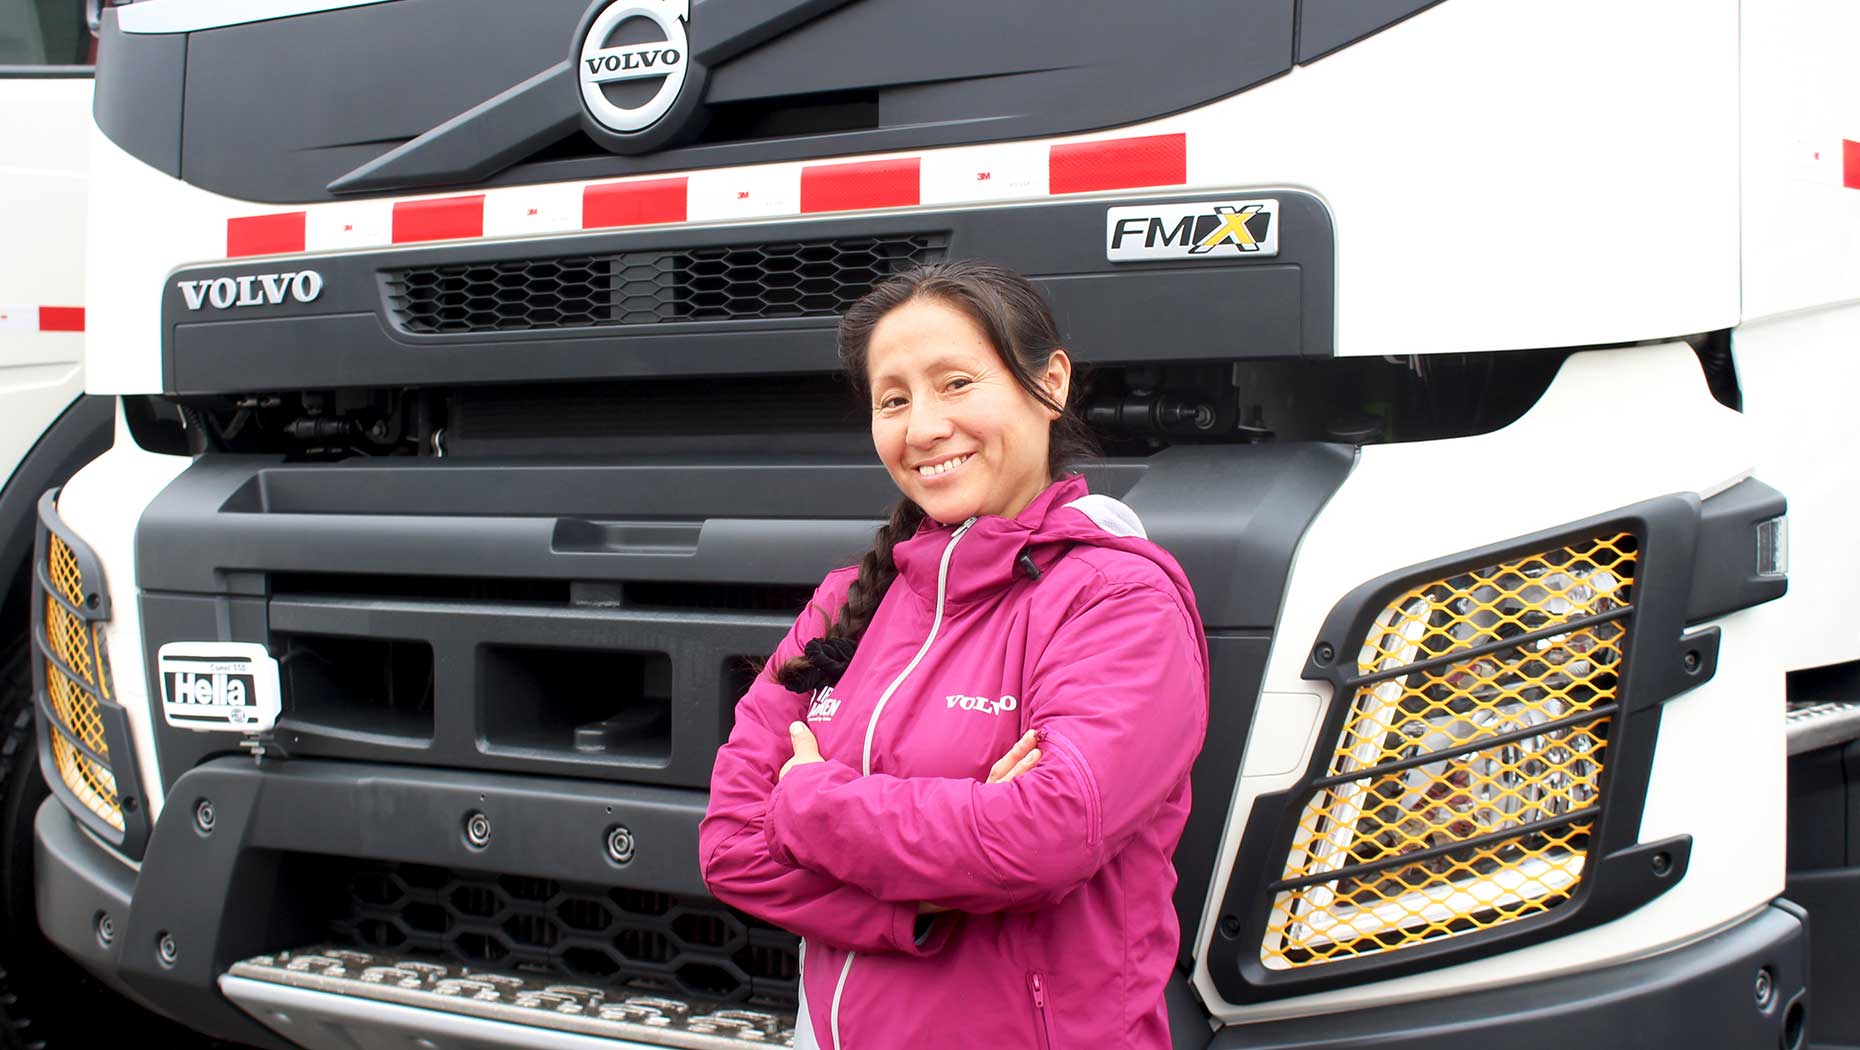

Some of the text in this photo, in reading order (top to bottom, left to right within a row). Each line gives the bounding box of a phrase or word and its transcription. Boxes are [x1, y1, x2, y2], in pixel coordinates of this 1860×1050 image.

[585, 49, 681, 75] VOLVO
[977, 171, 991, 182] 3M
[737, 191, 750, 201] 3M
[1111, 204, 1266, 254] FMX
[177, 270, 323, 310] VOLVO
[175, 672, 247, 706] Hella
[945, 694, 1017, 716] VOLVO
